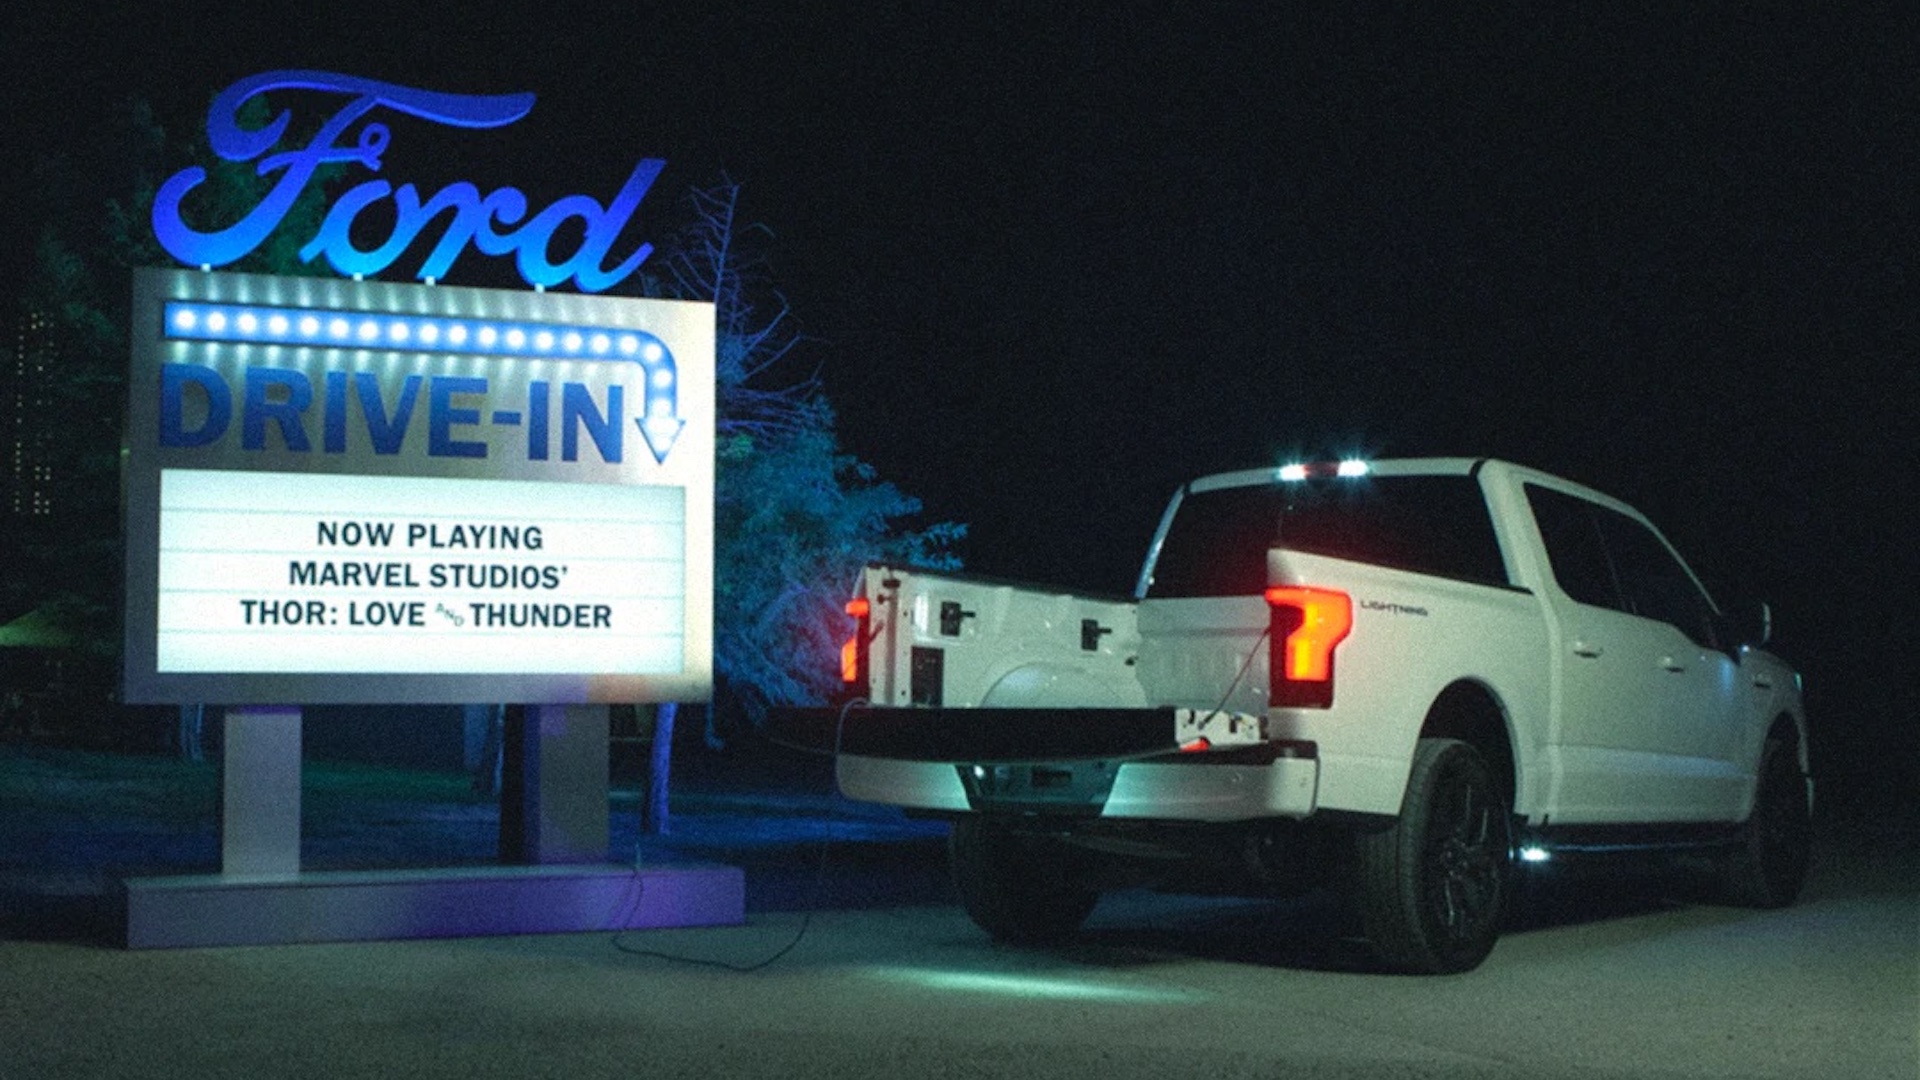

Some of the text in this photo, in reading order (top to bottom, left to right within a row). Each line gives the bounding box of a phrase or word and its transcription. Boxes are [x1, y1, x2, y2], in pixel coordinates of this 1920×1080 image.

[152, 70, 666, 292] Ford
[158, 363, 624, 464] DRIVE-IN
[317, 521, 543, 550] NOW PLAYING
[289, 561, 568, 590] MARVEL STUDIOS'
[240, 600, 338, 626] THOR:
[349, 601, 425, 627] LOVE
[469, 603, 612, 629] THUNDER
[1360, 600, 1429, 616] LIGHTNING
